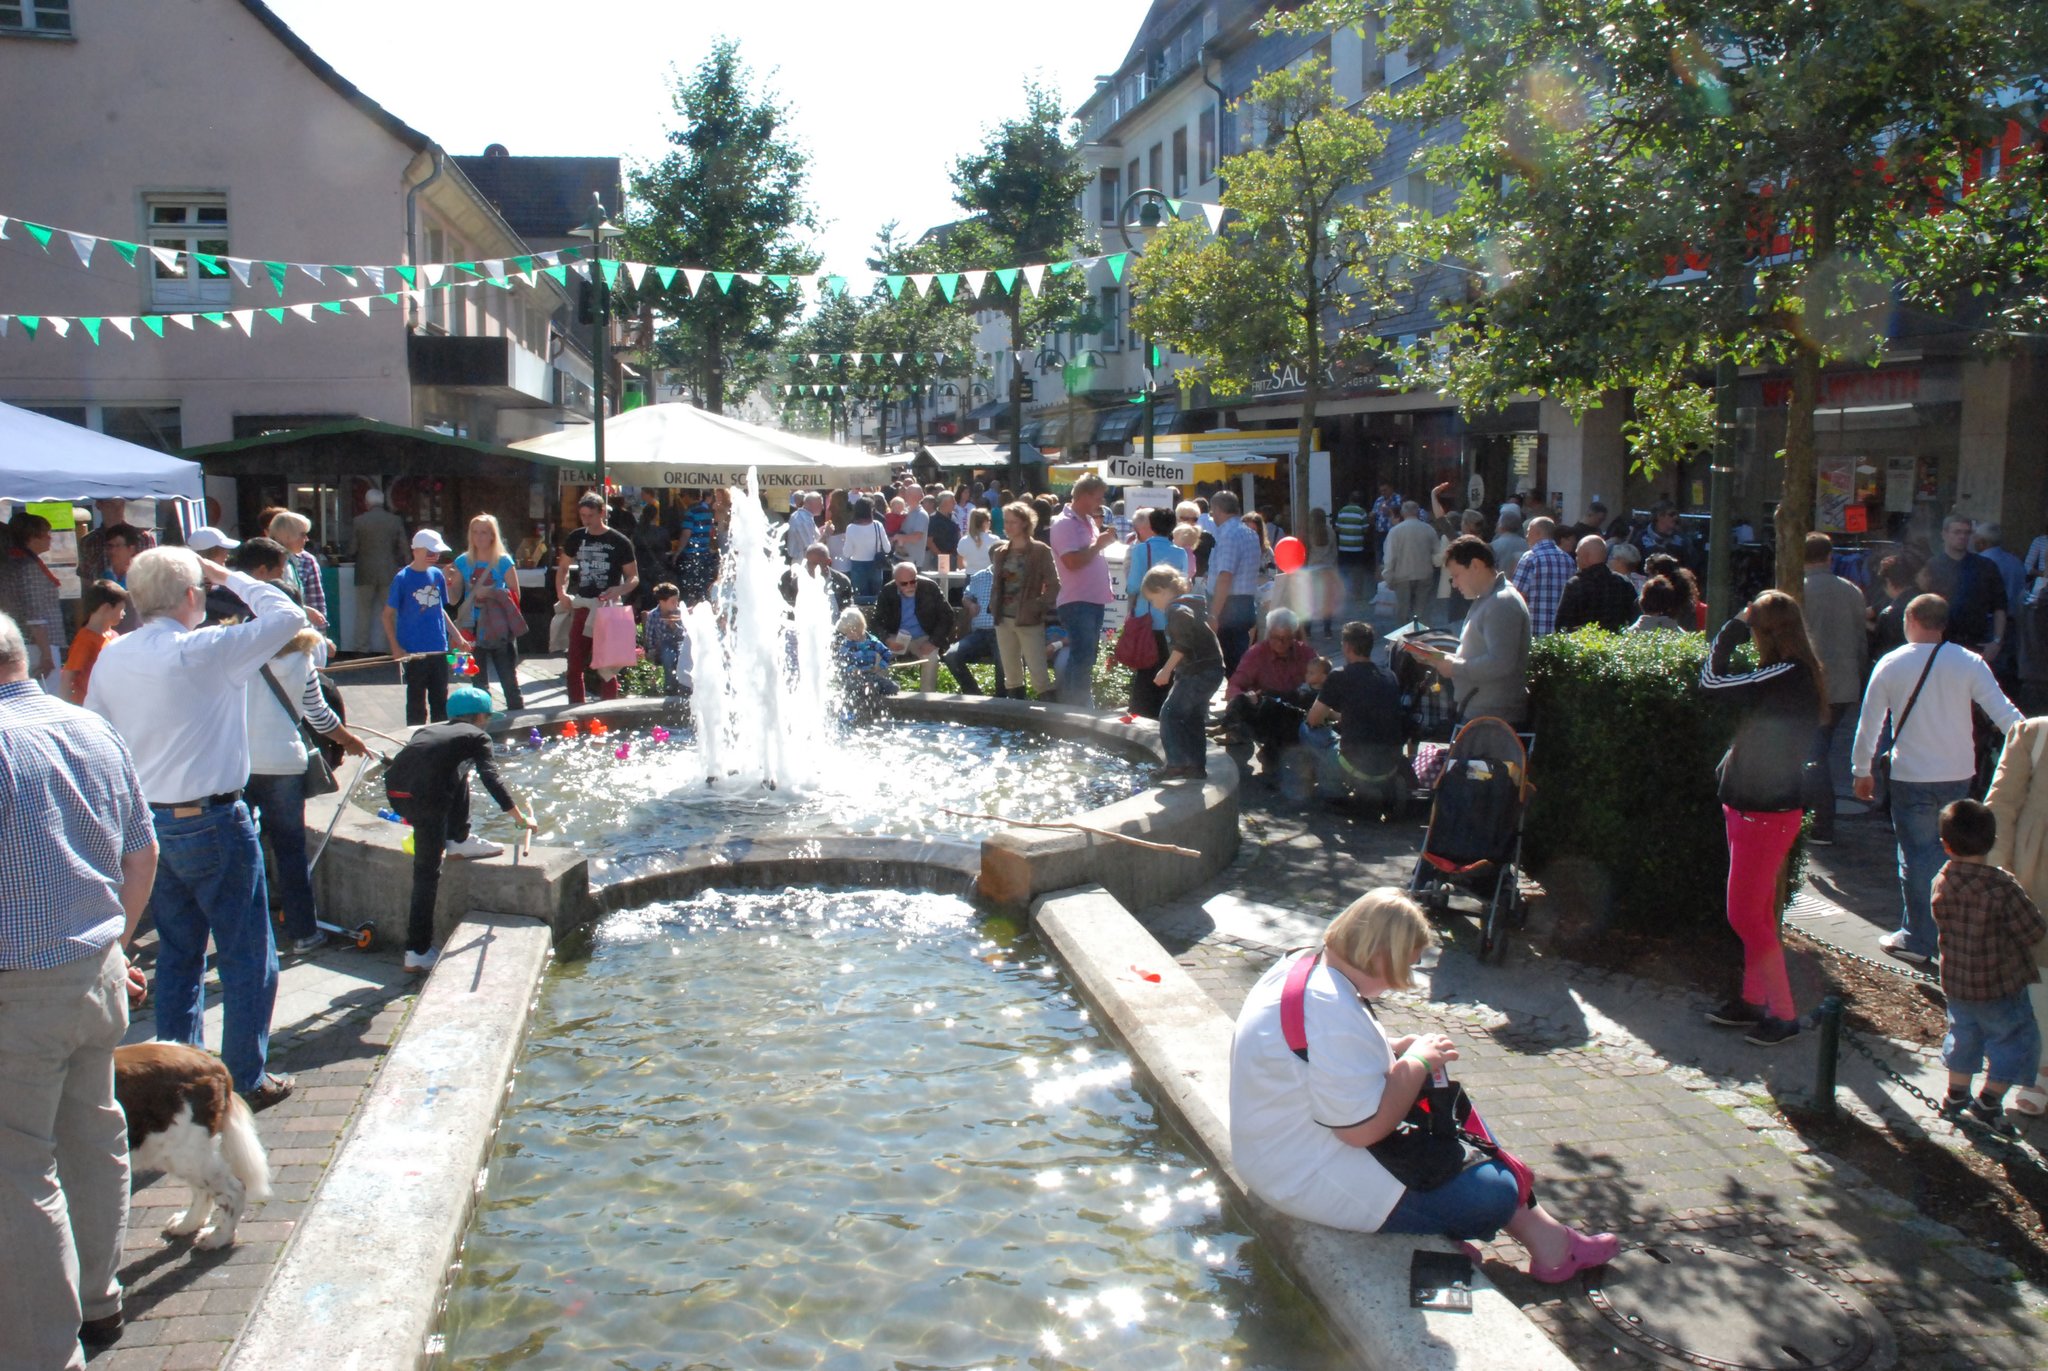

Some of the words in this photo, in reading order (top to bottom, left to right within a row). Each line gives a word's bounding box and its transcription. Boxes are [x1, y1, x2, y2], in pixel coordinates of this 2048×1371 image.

[1251, 379, 1272, 392] FRITZ
[1117, 459, 1184, 480] Toiletten
[663, 471, 726, 486] ORIGINAL
[730, 473, 826, 487] SCWENKGRILL
